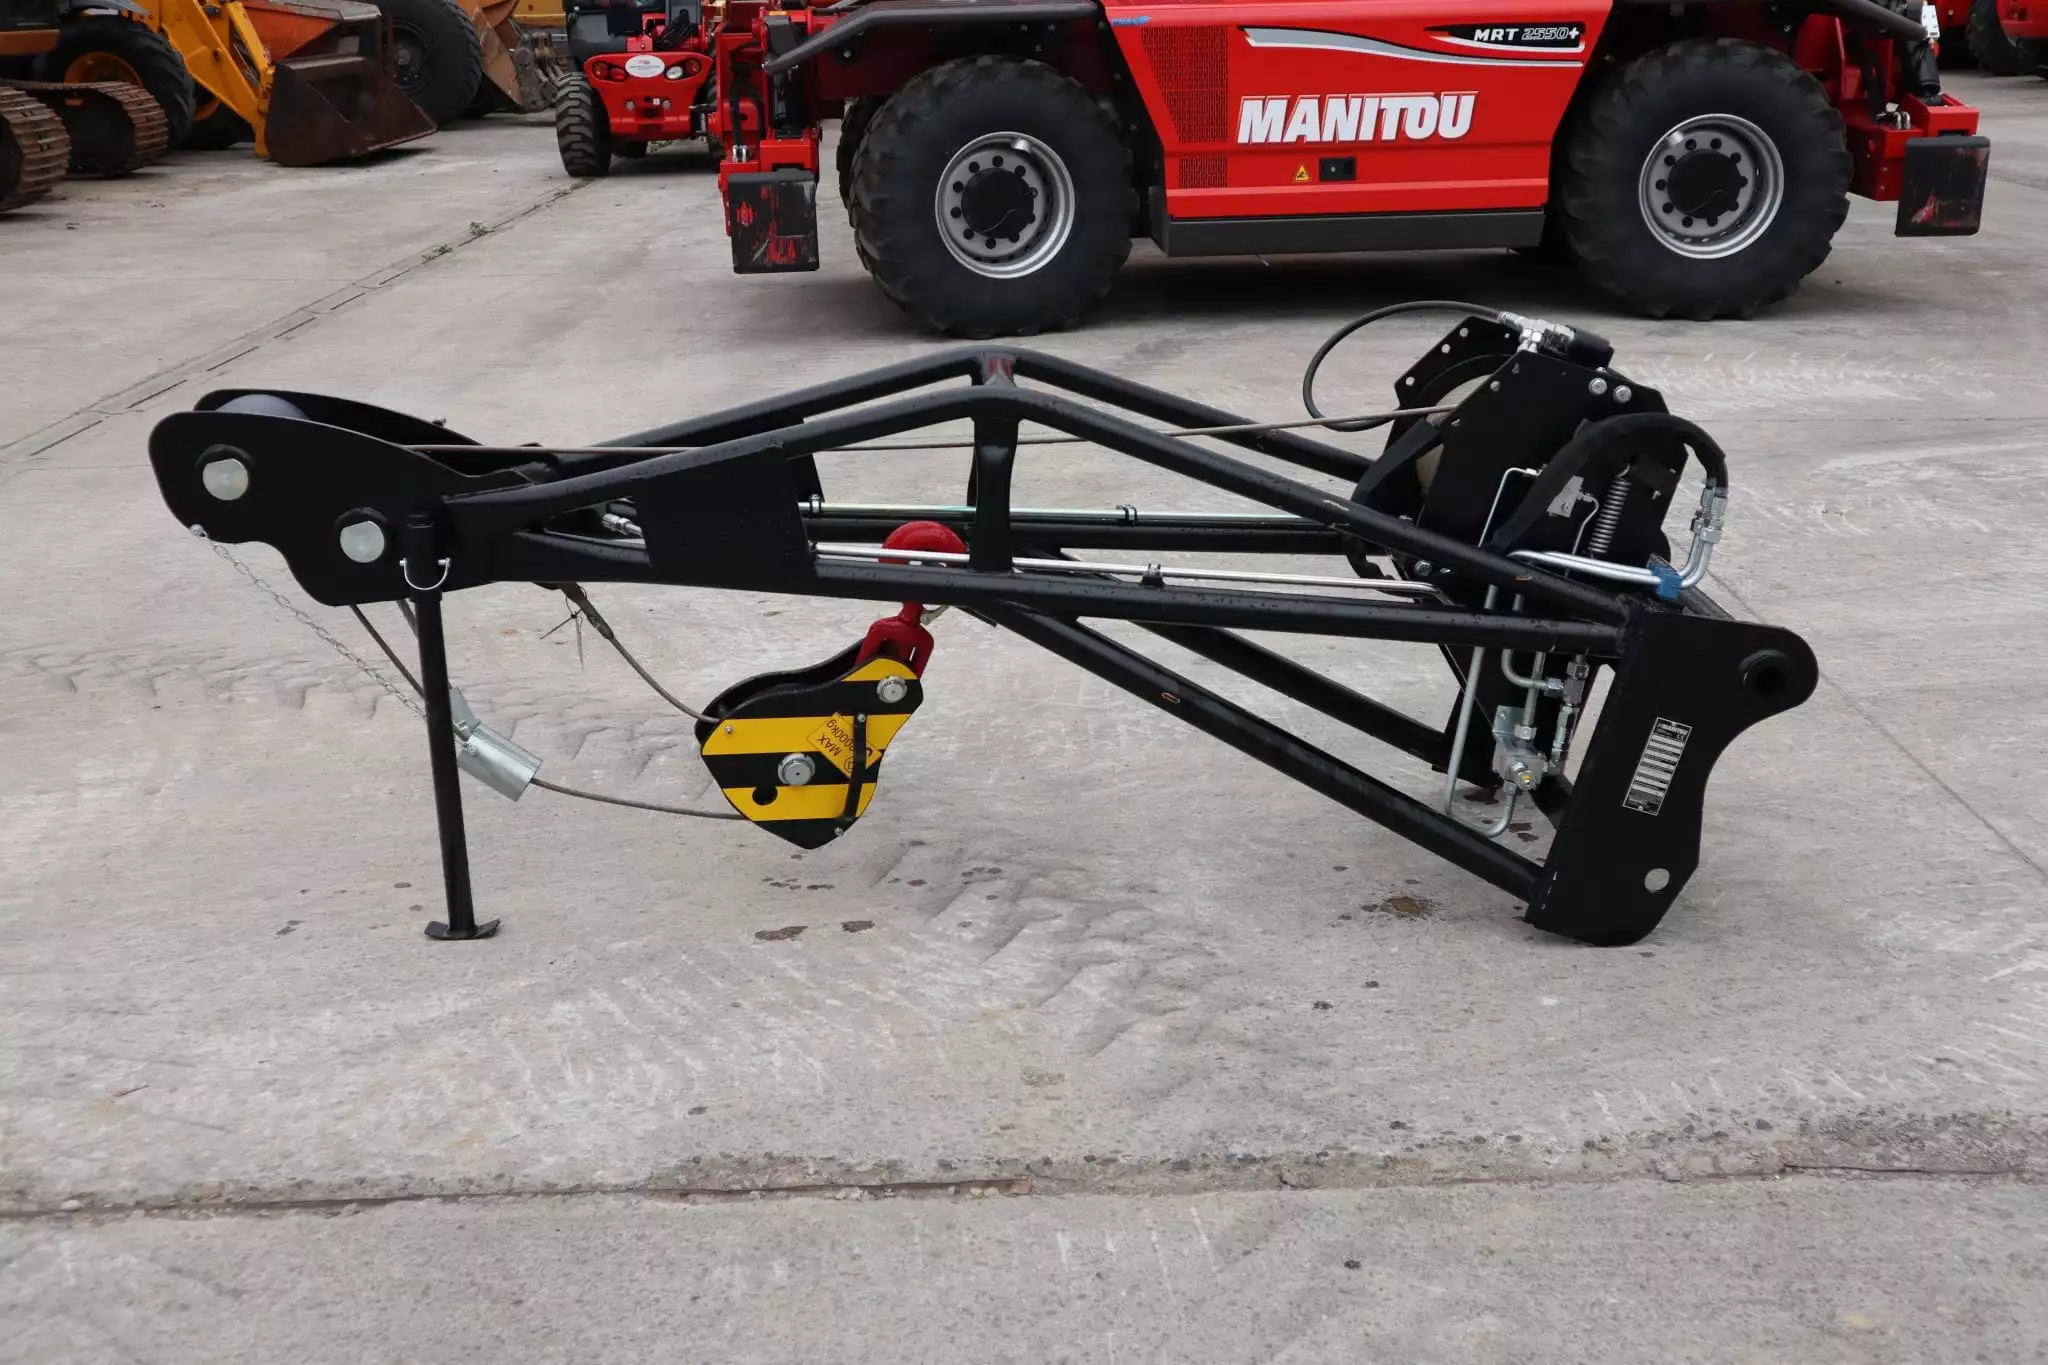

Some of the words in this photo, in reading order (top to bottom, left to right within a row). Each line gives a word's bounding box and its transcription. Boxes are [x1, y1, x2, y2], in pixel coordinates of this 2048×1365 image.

[1474, 28, 1519, 41] MRT
[1521, 27, 1580, 40] 2550+
[1237, 91, 1478, 144] MANITOU
[816, 733, 843, 756] MAX
